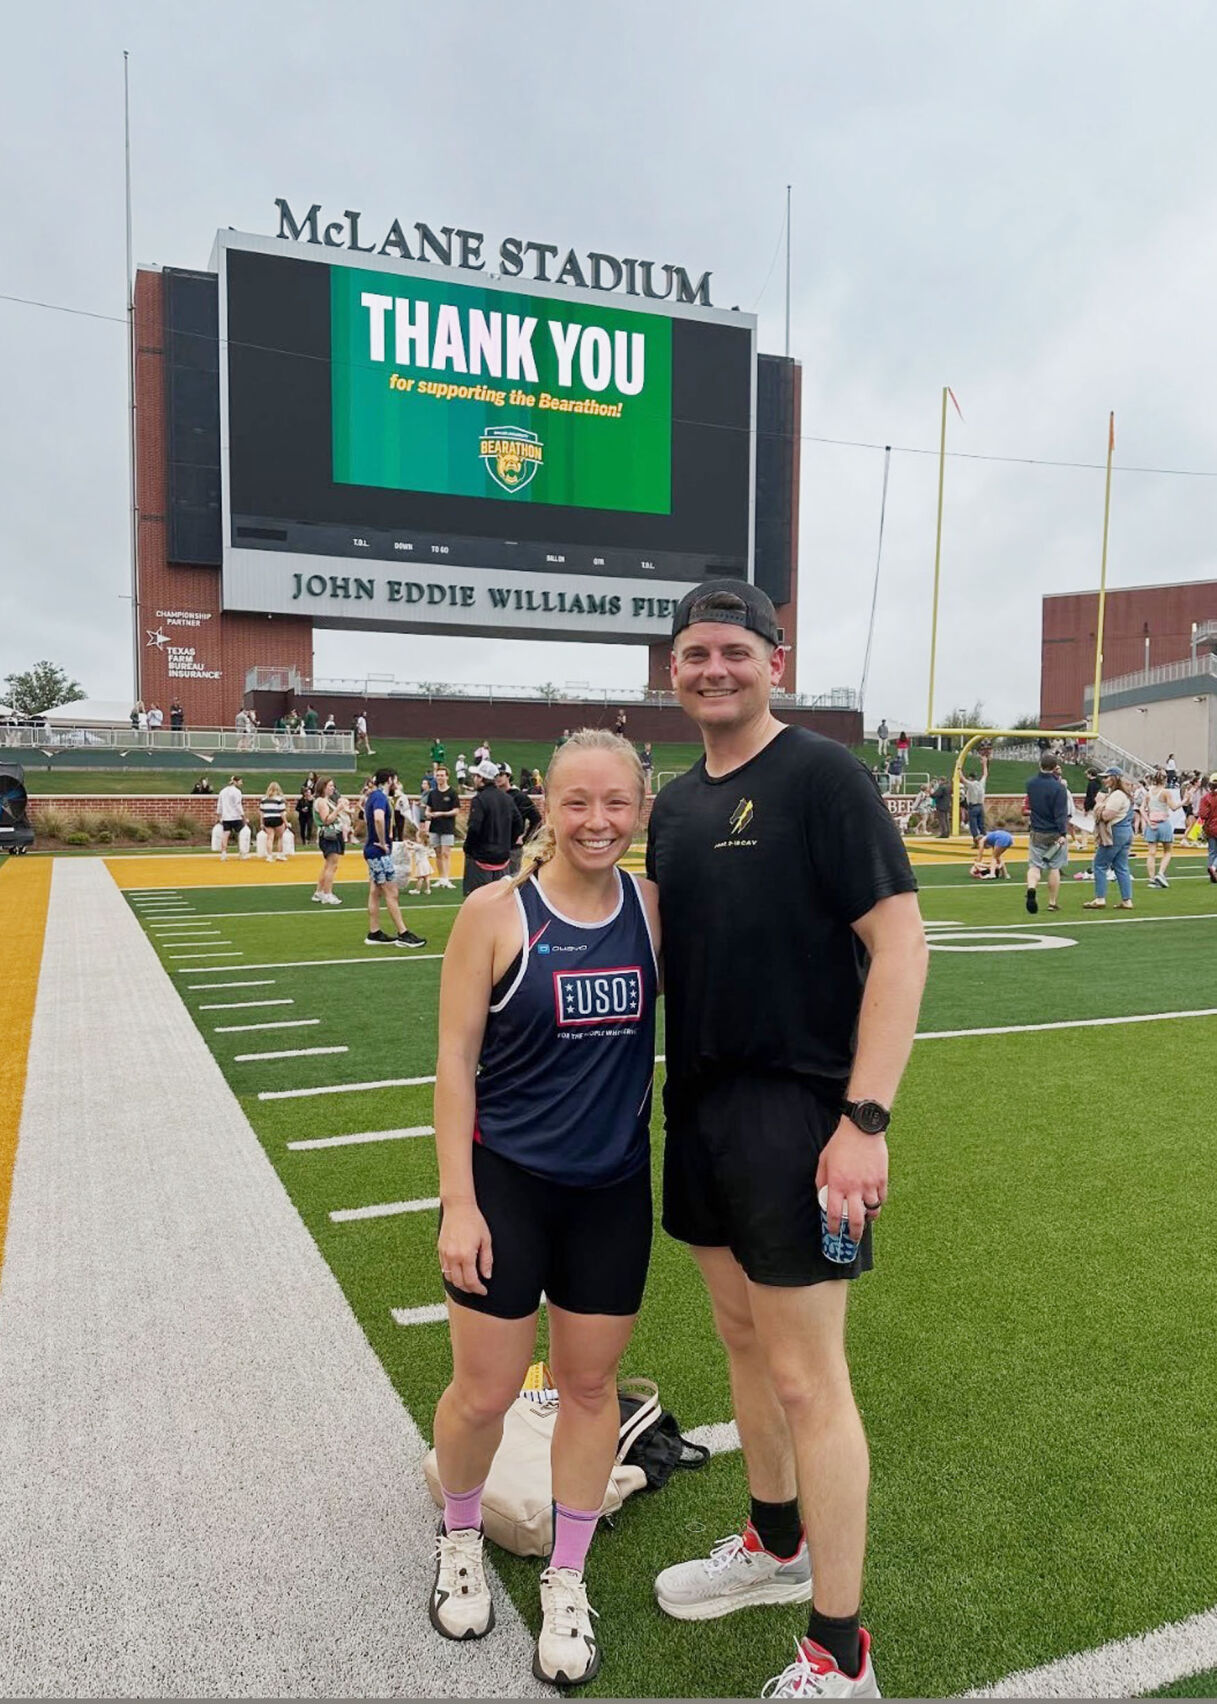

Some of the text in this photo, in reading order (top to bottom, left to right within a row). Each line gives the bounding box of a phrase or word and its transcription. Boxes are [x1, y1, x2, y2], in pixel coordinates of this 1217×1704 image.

[274, 198, 714, 307] McLANE STADIUM
[361, 292, 645, 396] THANK YOU
[389, 374, 623, 417] for supporting the Bearathon!
[481, 440, 542, 460] BEARATHON
[394, 542, 413, 550] DOWN
[431, 545, 449, 554] TO GO
[293, 573, 375, 600] JOHN
[387, 580, 475, 607] EDDIE
[488, 588, 621, 615] WILLIAMS
[156, 610, 212, 619] CHAMPIONSHIP
[167, 647, 195, 655] TEXAS
[168, 662, 205, 670] BUREAU
[576, 977, 627, 1015] USO
